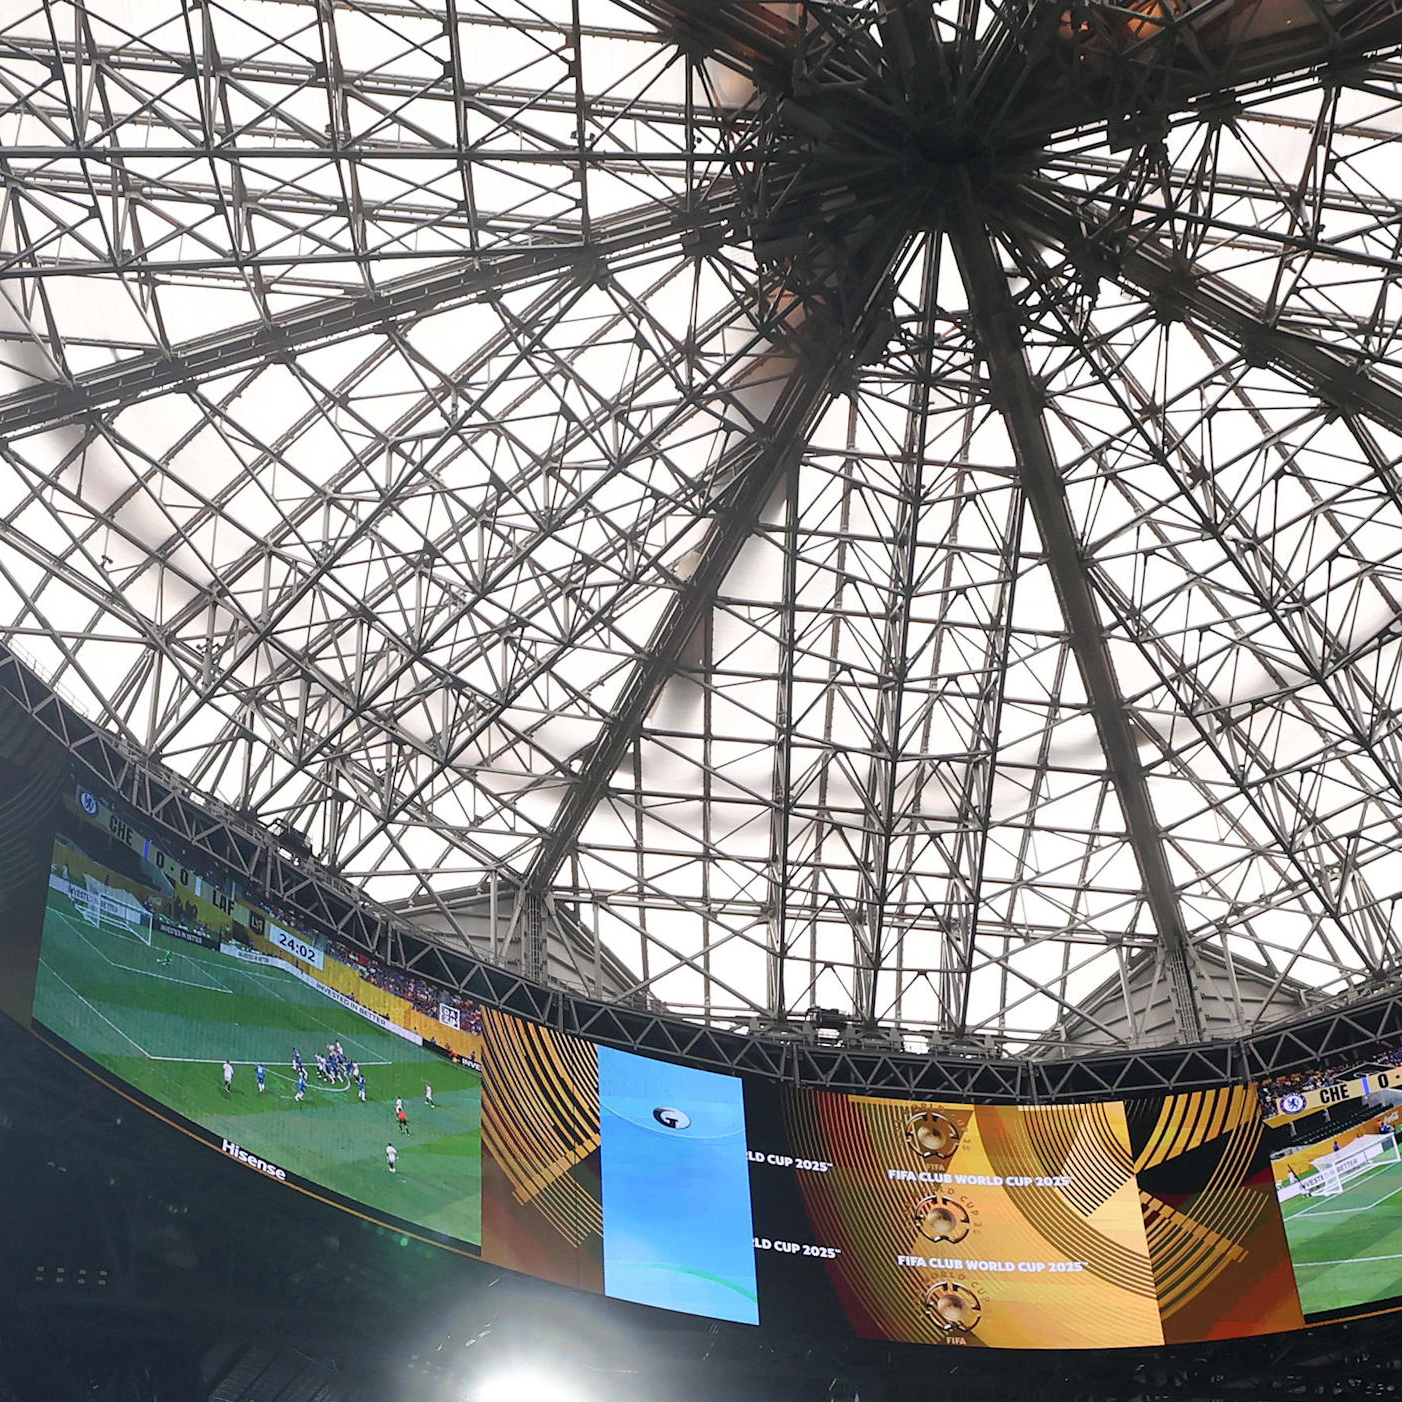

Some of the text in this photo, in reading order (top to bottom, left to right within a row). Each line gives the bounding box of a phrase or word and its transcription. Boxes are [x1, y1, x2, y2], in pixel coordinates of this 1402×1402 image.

[279, 933, 315, 963] 24:02
[1320, 1083, 1350, 1104] CHE
[1378, 1073, 1389, 1088] 0
[222, 1139, 285, 1179] Hisense
[767, 1154, 792, 1166] CUP
[888, 1169, 916, 1180] FIFA
[918, 1172, 952, 1182] CLUB
[954, 1174, 1002, 1185] WORLD
[1006, 1176, 1032, 1185] CUP
[773, 1240, 800, 1253] CUP
[897, 1255, 926, 1266] FIFA
[929, 1258, 962, 1268] CLUB
[965, 1260, 1014, 1271] WORLD
[1017, 1262, 1044, 1271] CUP
